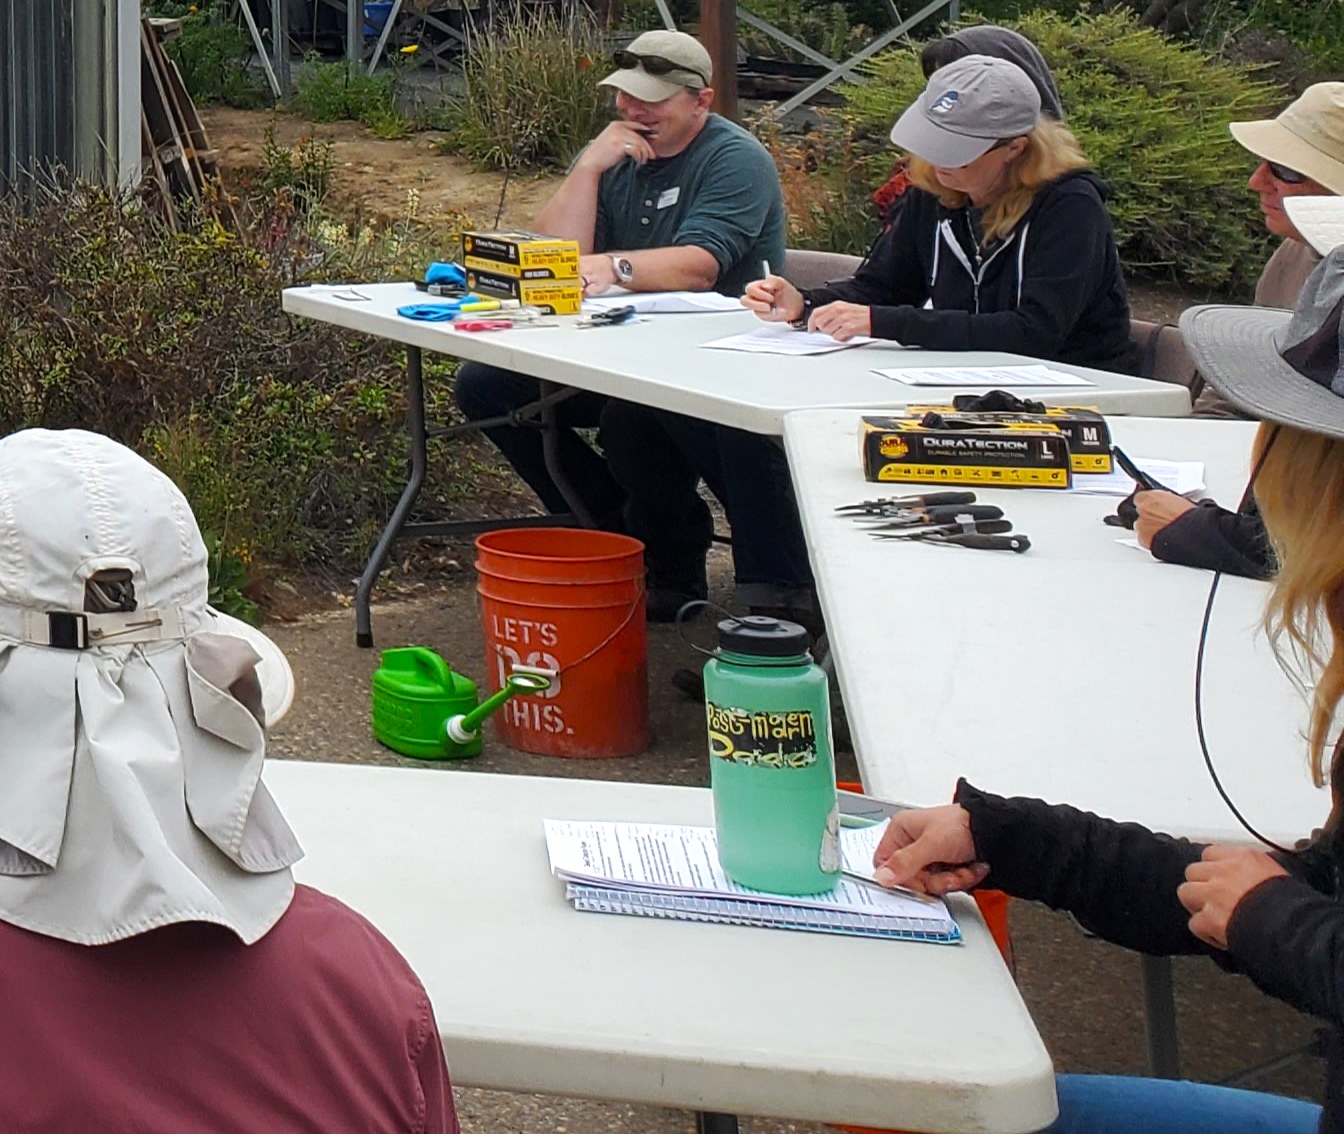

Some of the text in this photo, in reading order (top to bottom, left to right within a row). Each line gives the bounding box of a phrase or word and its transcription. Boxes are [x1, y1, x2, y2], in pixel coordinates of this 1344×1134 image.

[922, 437, 1028, 451] DURATECTION
[1041, 440, 1053, 455] L
[1082, 427, 1098, 441] M
[493, 614, 559, 648] LET'S
[503, 697, 575, 735] THIS.
